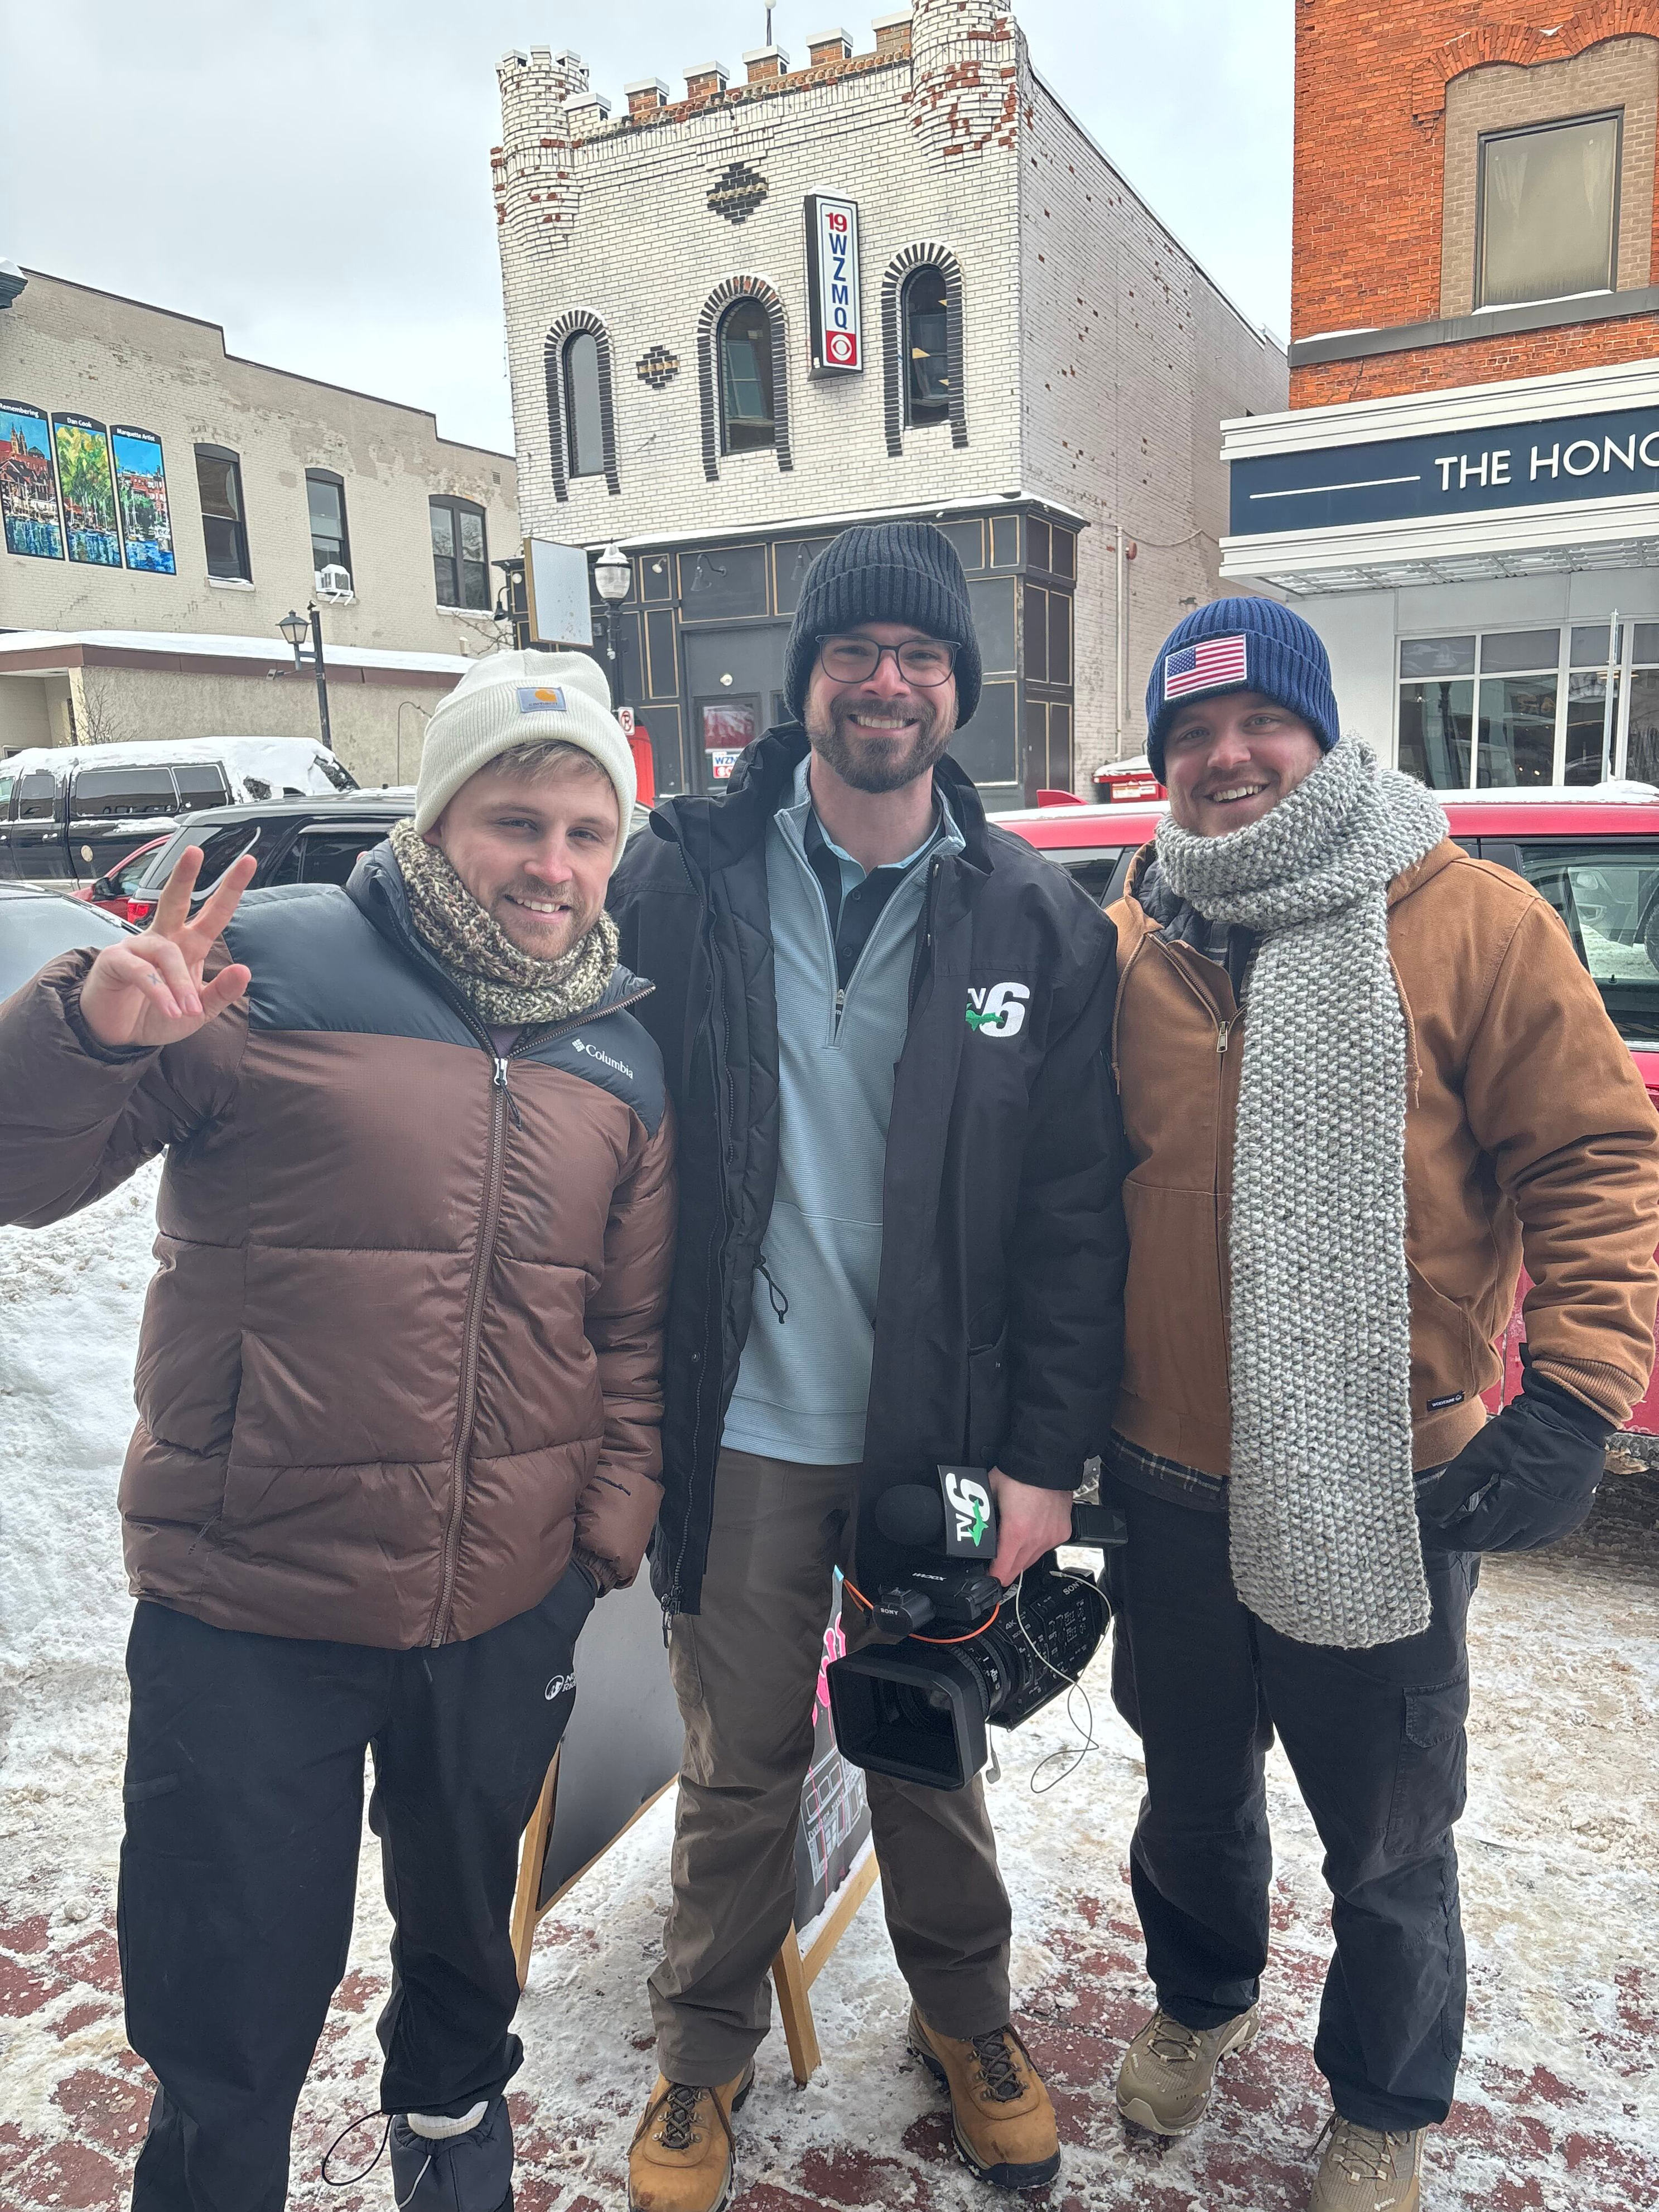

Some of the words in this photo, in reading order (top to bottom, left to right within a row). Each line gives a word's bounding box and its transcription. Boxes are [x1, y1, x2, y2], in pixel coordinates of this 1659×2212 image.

[825, 212, 847, 232] 19
[828, 233, 848, 330] WZMQ
[0, 403, 39, 418] Remembering
[67, 417, 78, 426] Dan
[78, 419, 92, 428] Cook
[116, 428, 141, 439] Marquette
[142, 433, 156, 442] Artist
[1435, 450, 1511, 491] THE
[586, 1044, 633, 1079] Columbia
[945, 1472, 990, 1542] TV6
[1005, 1619, 1017, 1630] 4K
